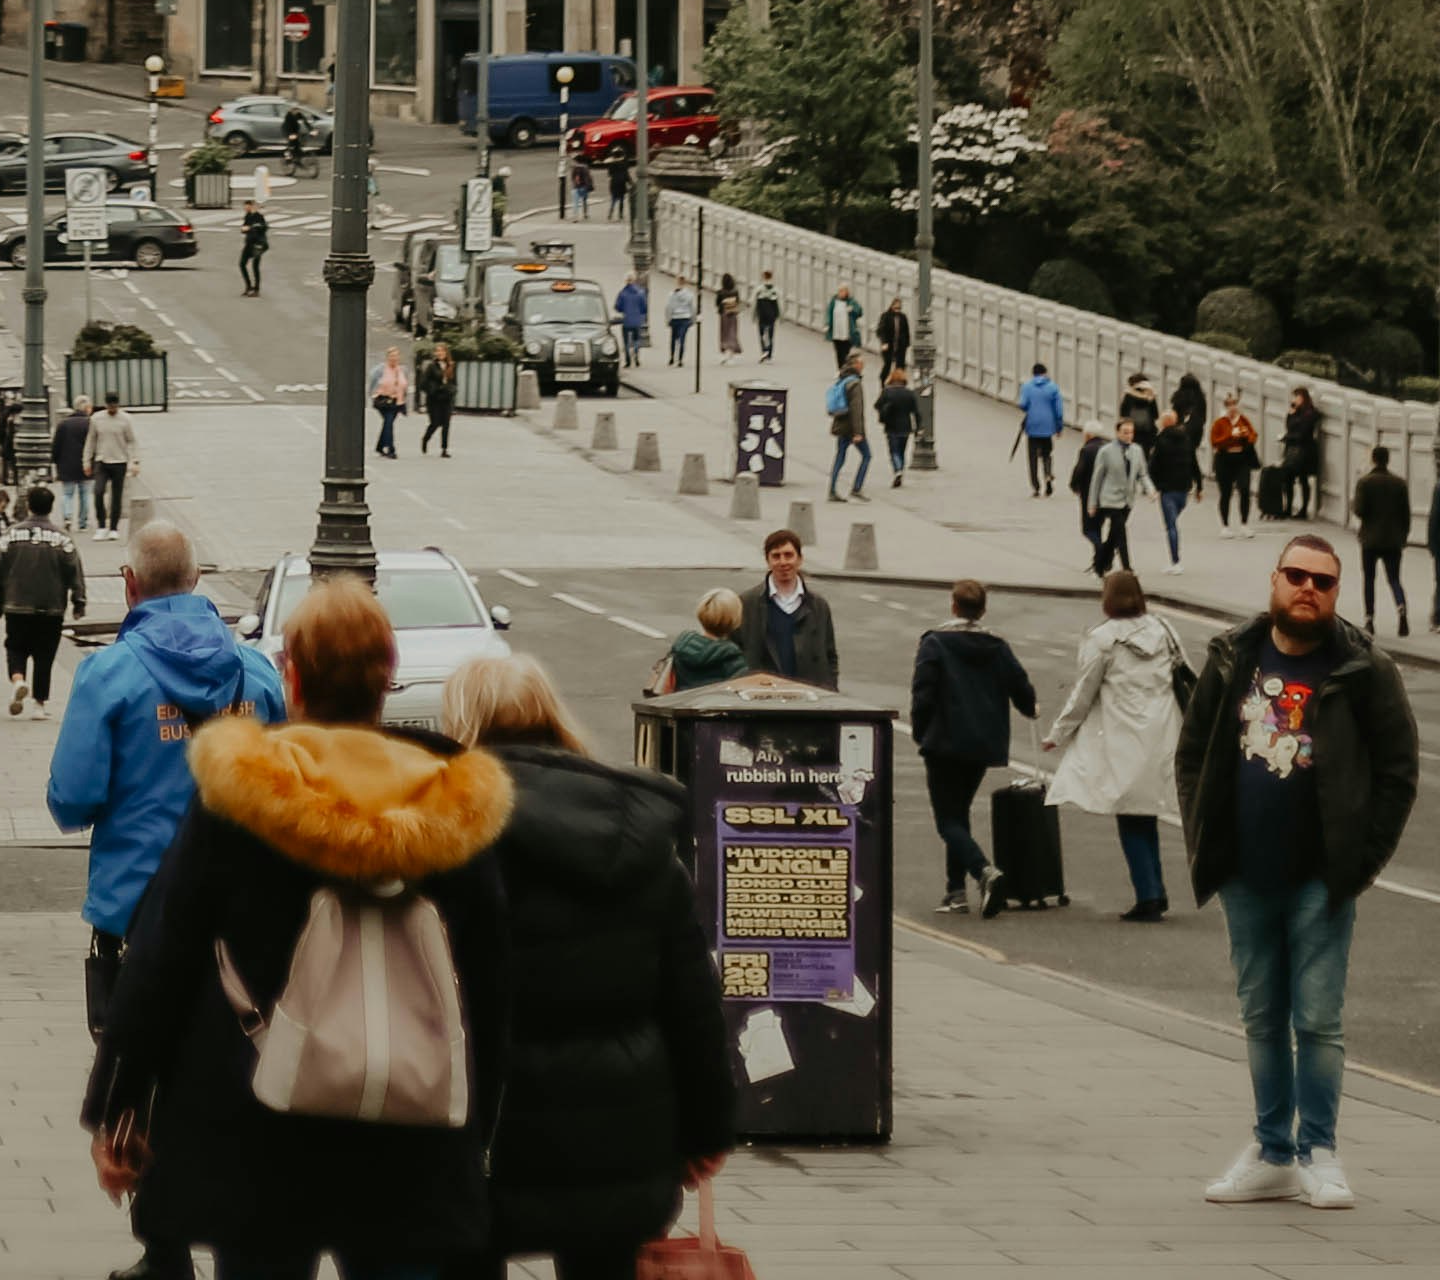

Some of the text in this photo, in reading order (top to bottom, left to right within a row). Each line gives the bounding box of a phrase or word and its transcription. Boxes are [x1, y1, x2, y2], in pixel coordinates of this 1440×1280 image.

[160, 724, 193, 741] BUS
[726, 769, 786, 783] rubbish
[790, 769, 805, 783] in
[724, 807, 849, 826] SSL XL
[726, 847, 848, 859] HARDCORE 2
[726, 858, 848, 874] JUNGLE
[726, 878, 847, 890] BONGO CLUB
[726, 893, 847, 904] 23:00 03:00
[726, 908, 847, 920] POWERED BY
[726, 918, 847, 929] MESSENGER
[726, 928, 847, 938] SOUND SYSTEM
[723, 953, 768, 968] FRI
[723, 967, 768, 986] 29
[723, 985, 768, 997] APR
